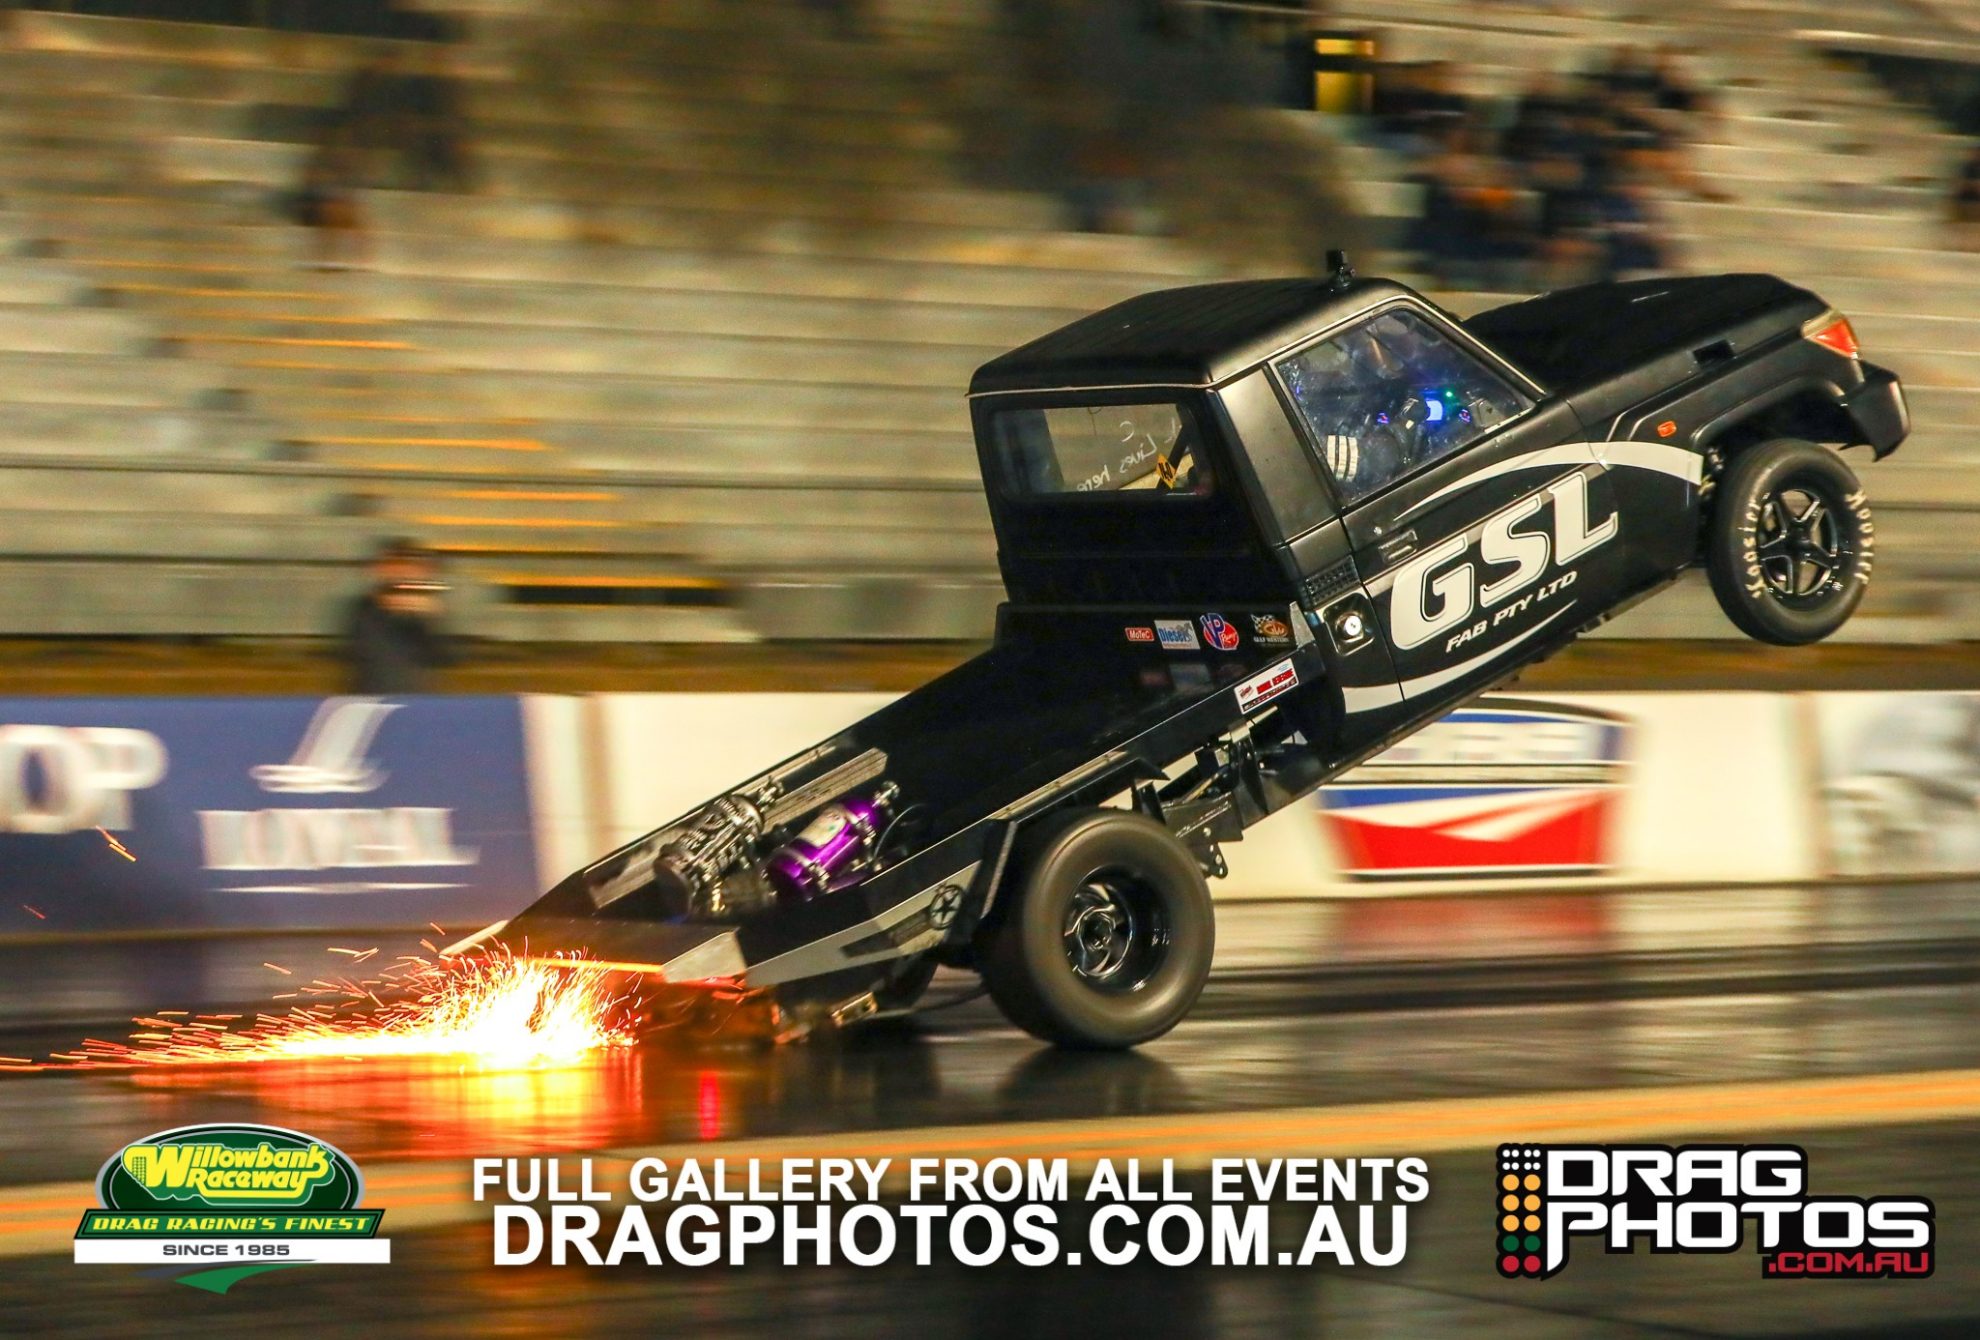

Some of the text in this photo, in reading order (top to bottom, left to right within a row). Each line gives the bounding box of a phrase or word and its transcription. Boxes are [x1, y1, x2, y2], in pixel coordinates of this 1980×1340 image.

[1390, 471, 1619, 650] GSL
[1129, 629, 1151, 640] MoTeC
[1446, 571, 1578, 653] FAB PTY LTD
